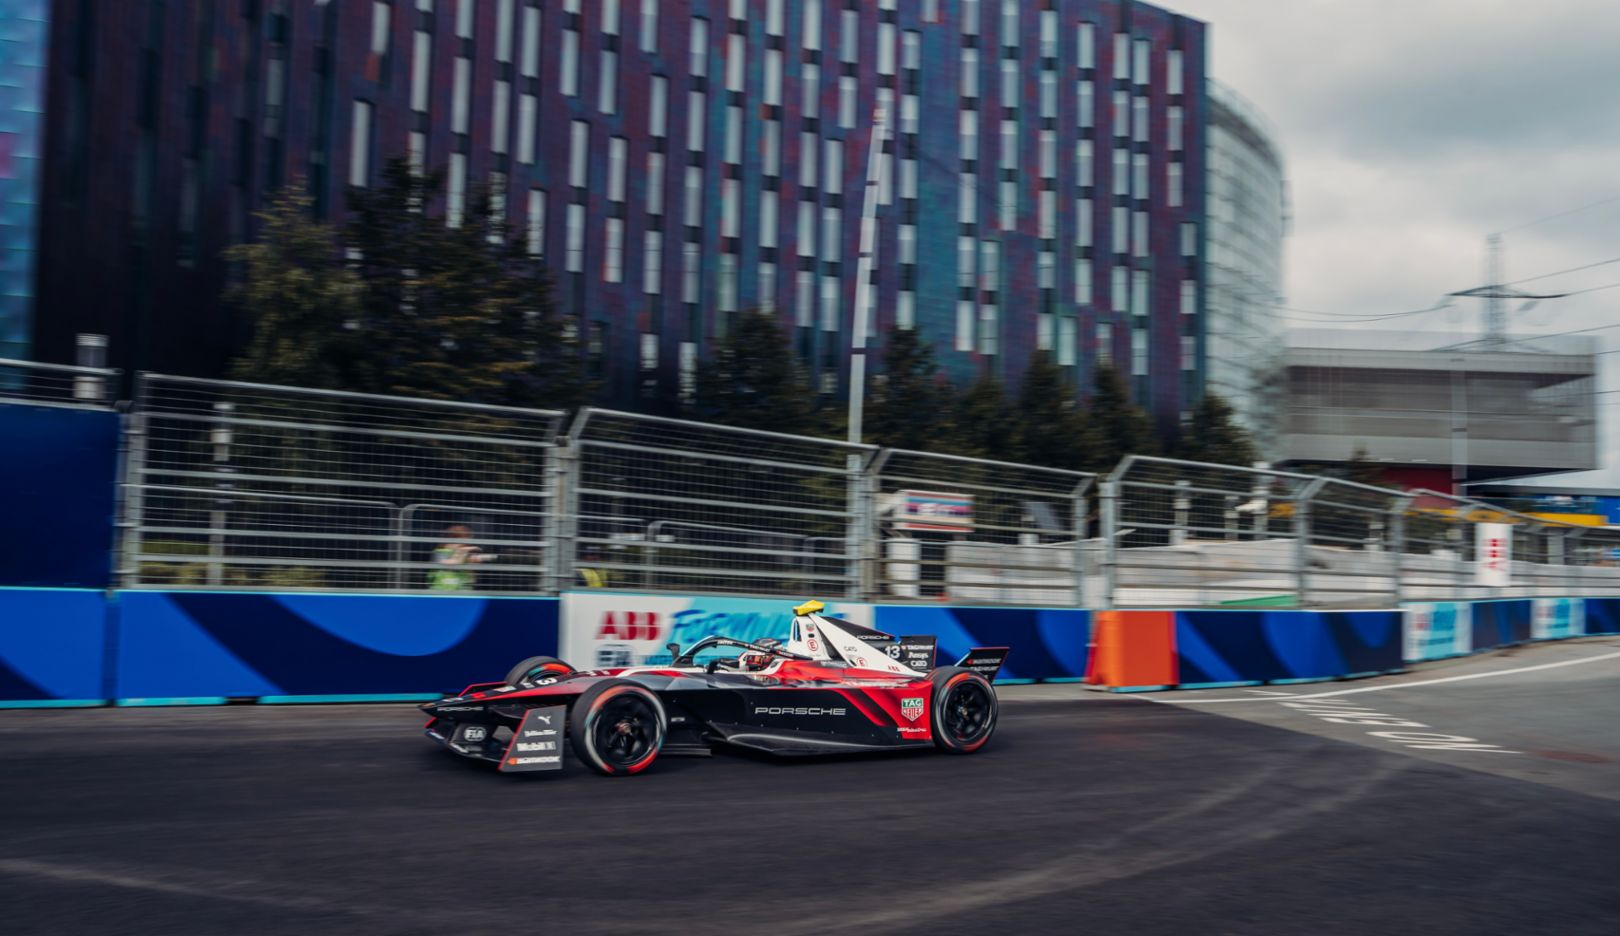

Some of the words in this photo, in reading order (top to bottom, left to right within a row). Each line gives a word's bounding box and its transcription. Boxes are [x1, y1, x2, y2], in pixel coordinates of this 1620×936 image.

[595, 611, 662, 640] ABB
[884, 645, 900, 659] 13
[903, 700, 922, 708] TAG
[754, 707, 847, 716] PORSCHE
[465, 729, 484, 739] FIA
